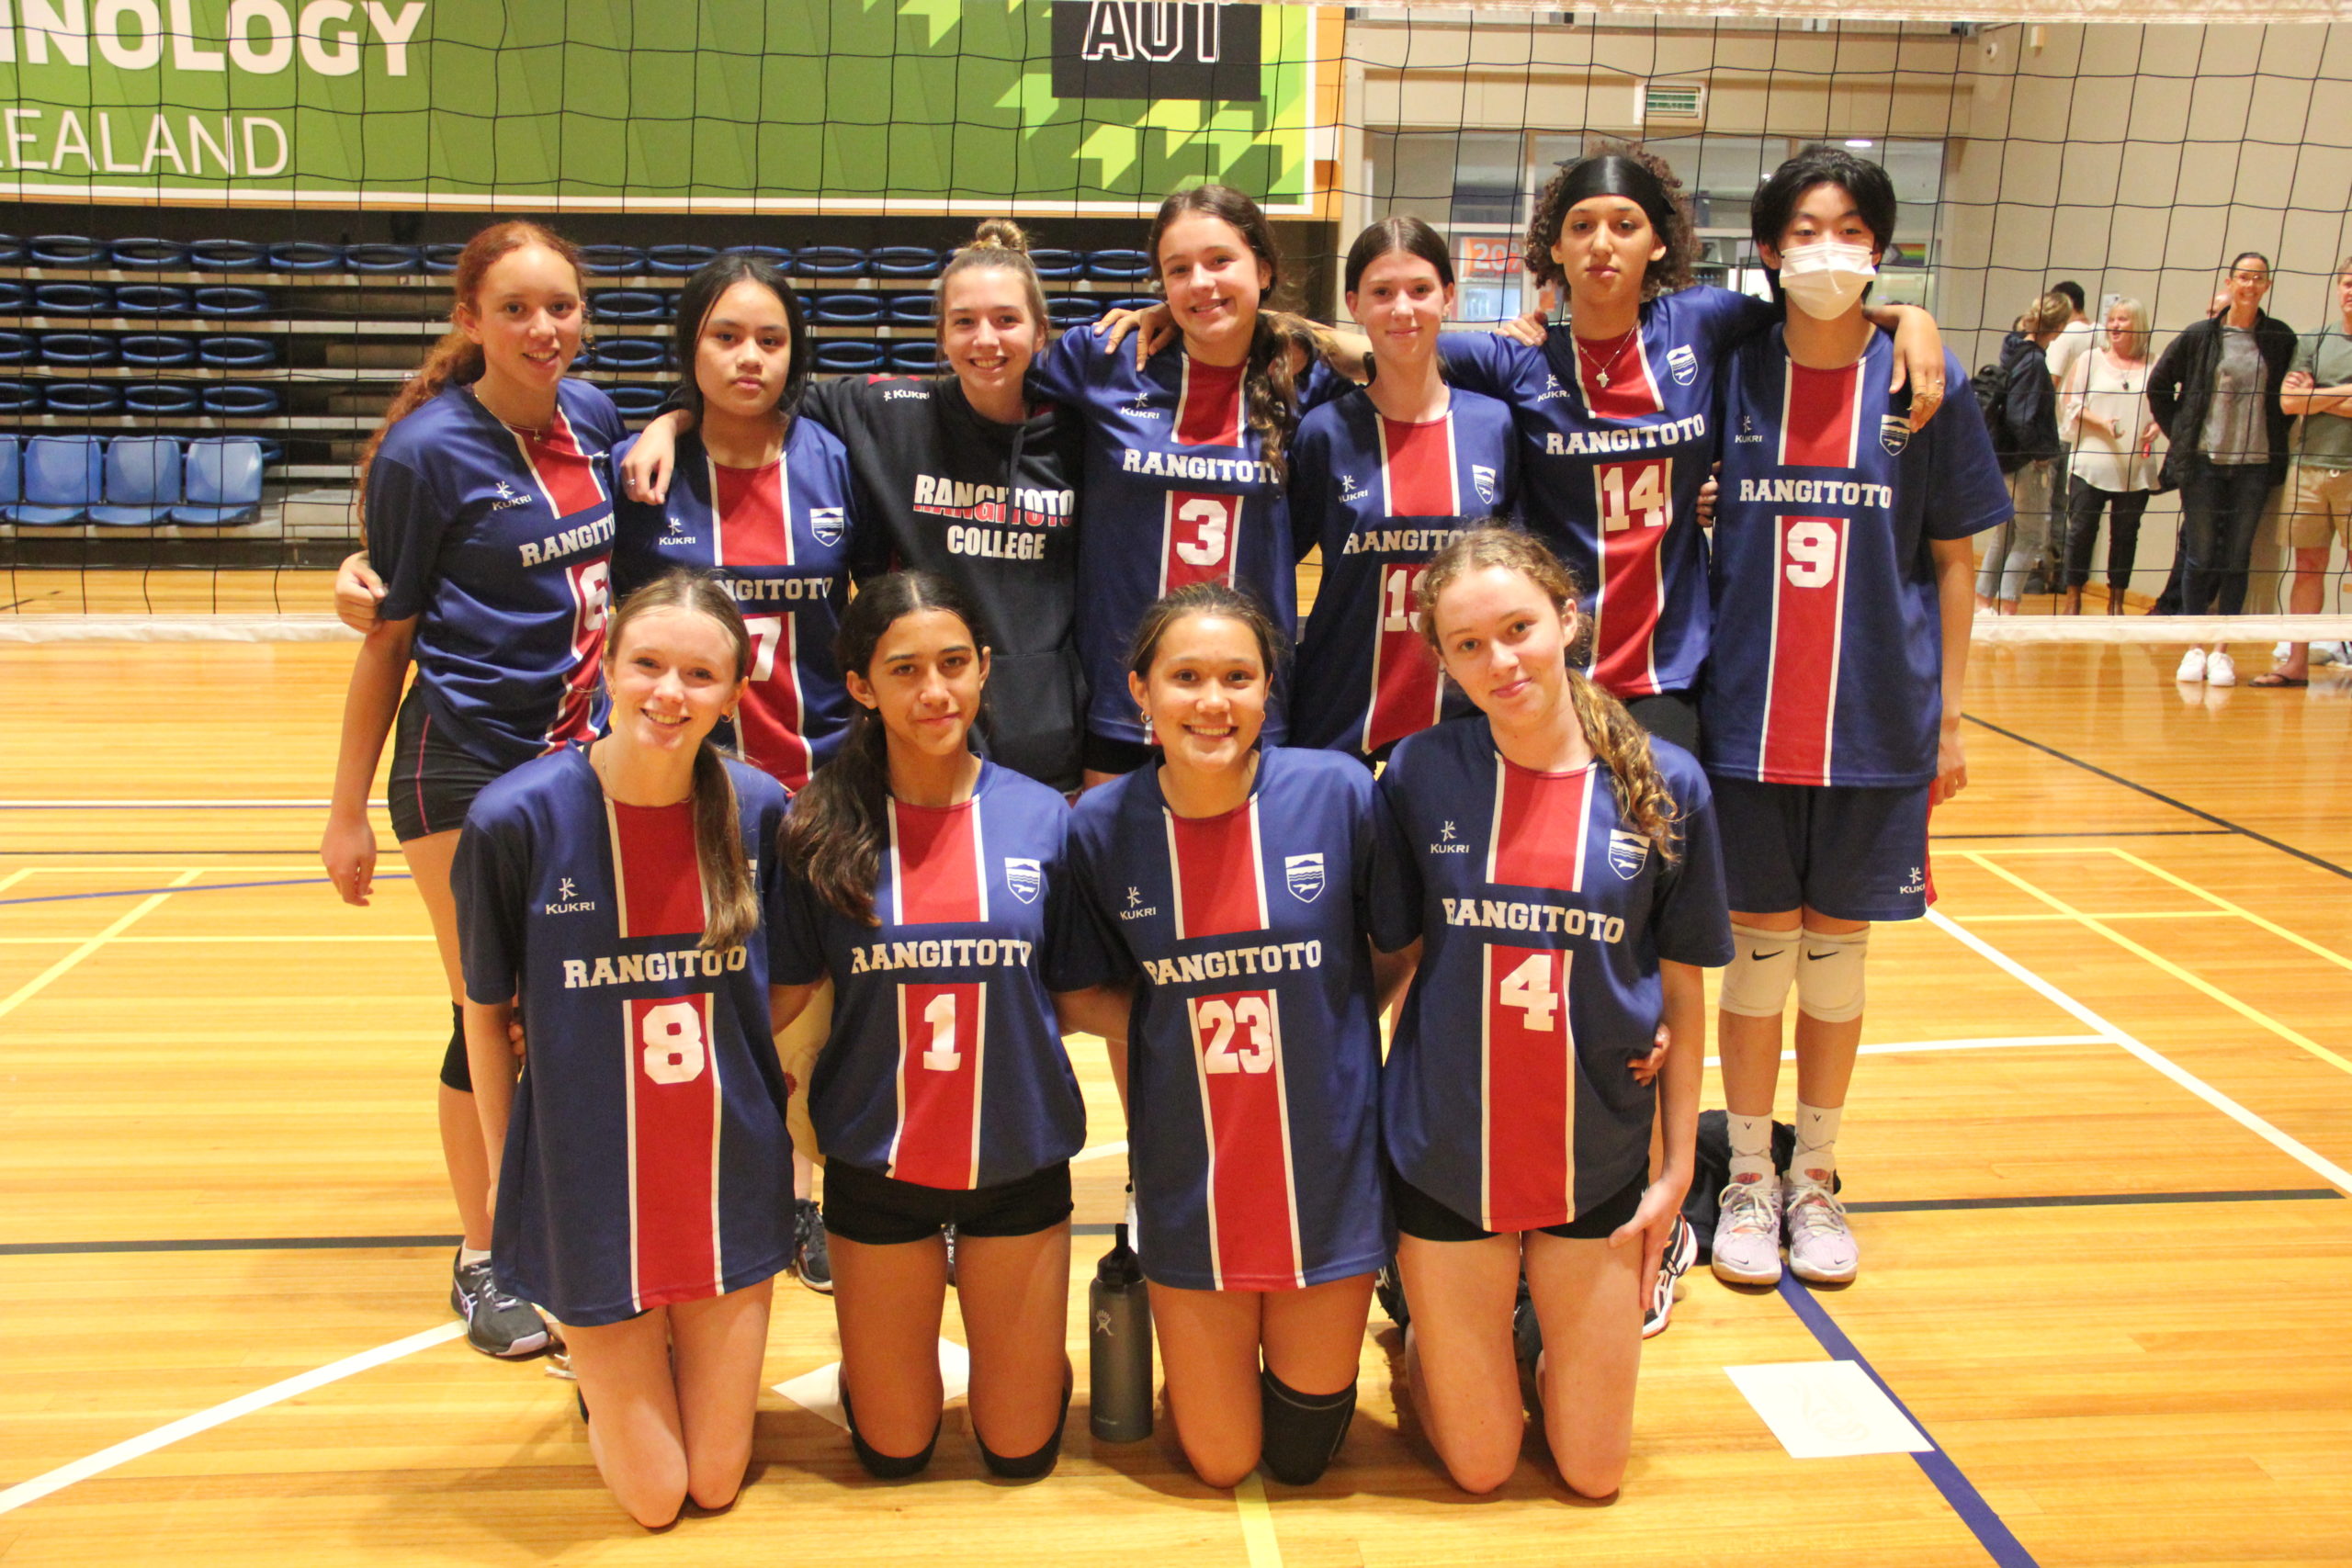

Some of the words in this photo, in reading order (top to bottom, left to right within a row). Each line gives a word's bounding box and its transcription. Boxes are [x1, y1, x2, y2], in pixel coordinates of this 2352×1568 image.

[1081, 0, 1232, 62] AUT
[0, 107, 288, 176] EALAND
[893, 389, 930, 400] KUKRI
[1120, 406, 1159, 419] KUKRI
[1545, 413, 1705, 456] RANGITOTO
[1735, 434, 1763, 444] KUKRI
[492, 494, 532, 511] KUKRI
[913, 474, 1075, 527] RANGITOTO
[1602, 465, 1665, 532] 14
[1739, 479, 1893, 509] RANGITOTO
[518, 510, 616, 568] RANGITO
[659, 536, 696, 546] KUKRI
[946, 525, 1046, 560] COLLEGE
[1176, 498, 1228, 566] 3
[1342, 529, 1476, 555] RANGITO
[1786, 521, 1838, 589] 9
[743, 616, 782, 682] 7
[1430, 843, 1470, 854] KUKRI
[545, 901, 595, 915] KUKRI
[1120, 907, 1157, 921] KUKRI
[1442, 897, 1625, 944] RANGITOTO
[562, 945, 747, 989] RANGITOO
[851, 939, 1033, 975] RANGITOTO
[1142, 940, 1321, 986] RANGITOTO
[1499, 953, 1559, 1032] 4
[642, 1001, 705, 1085] 8
[922, 993, 962, 1072] 1
[1197, 997, 1274, 1074] 23
